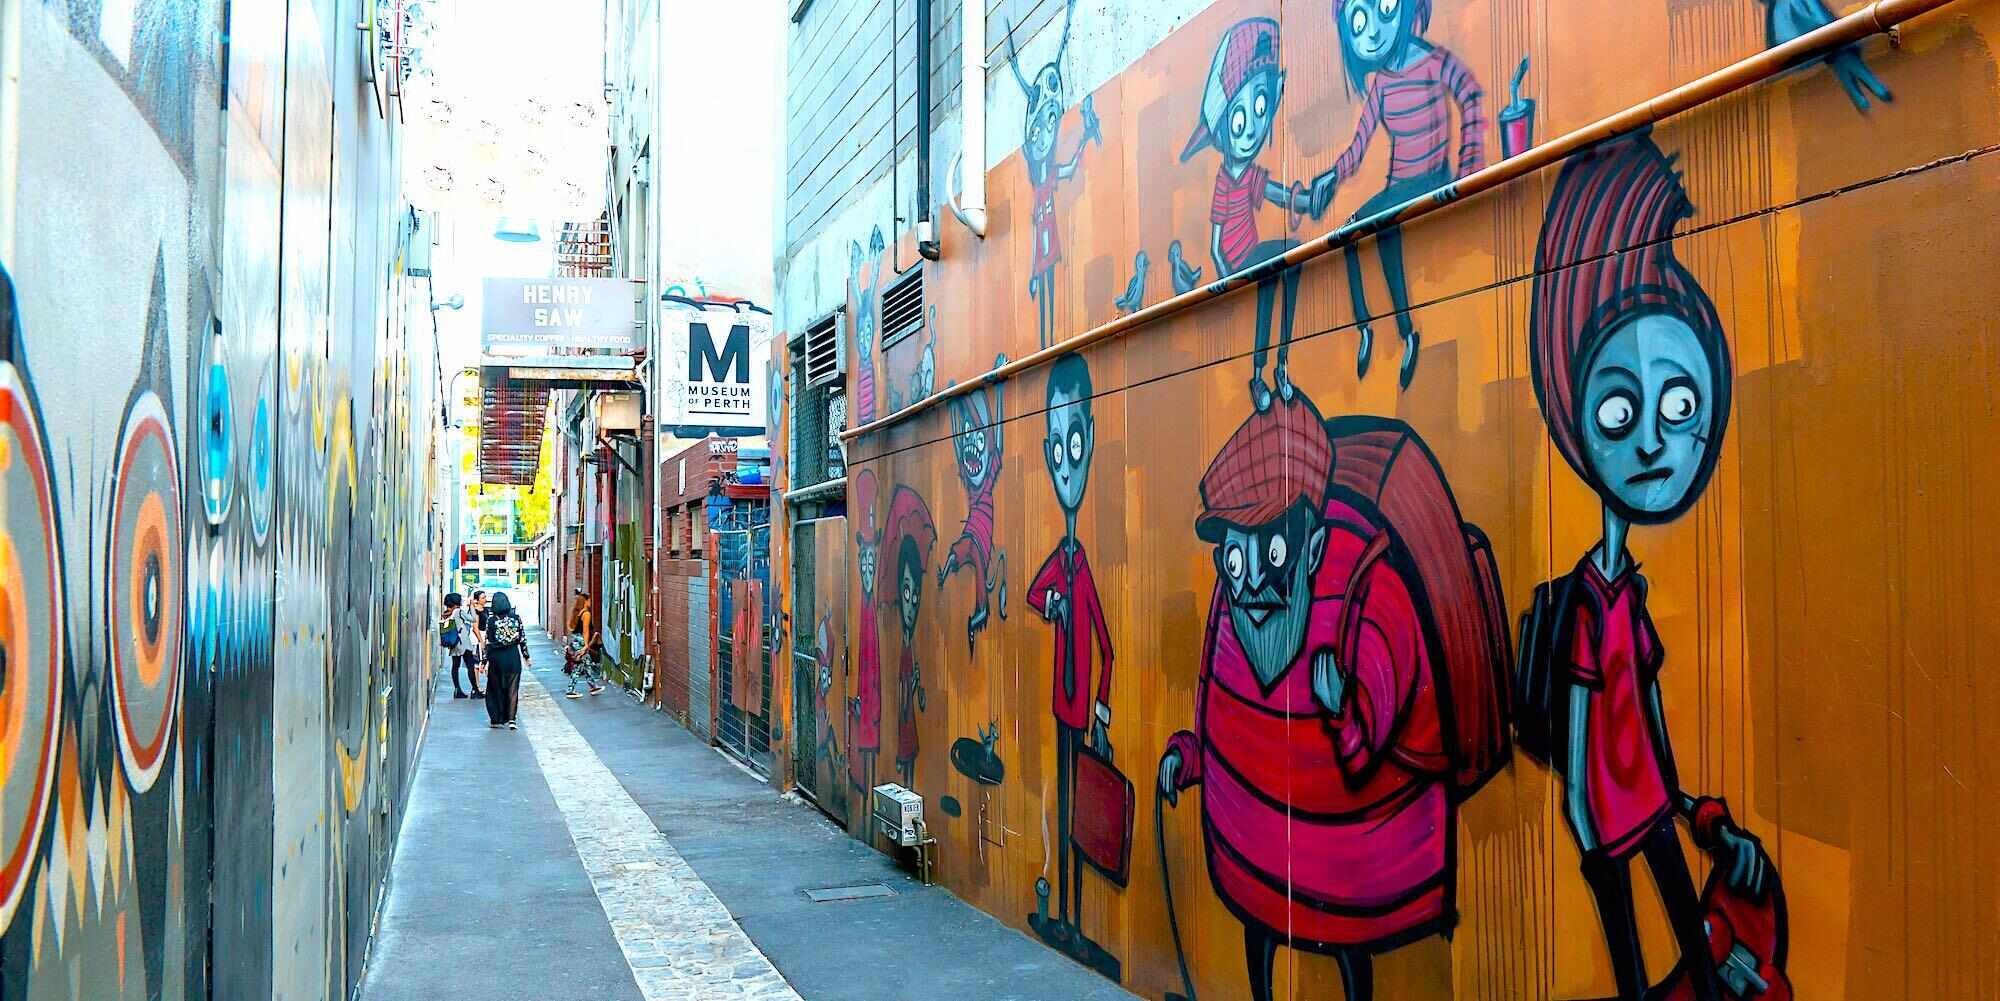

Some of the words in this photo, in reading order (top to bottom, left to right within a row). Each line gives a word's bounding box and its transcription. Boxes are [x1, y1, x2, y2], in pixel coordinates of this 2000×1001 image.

[524, 285, 592, 304] HENRY
[534, 308, 583, 327] SAW
[610, 335, 631, 344] FOOD
[689, 323, 750, 383] M
[688, 386, 750, 397] MUSEUM
[704, 398, 750, 409] PERTH
